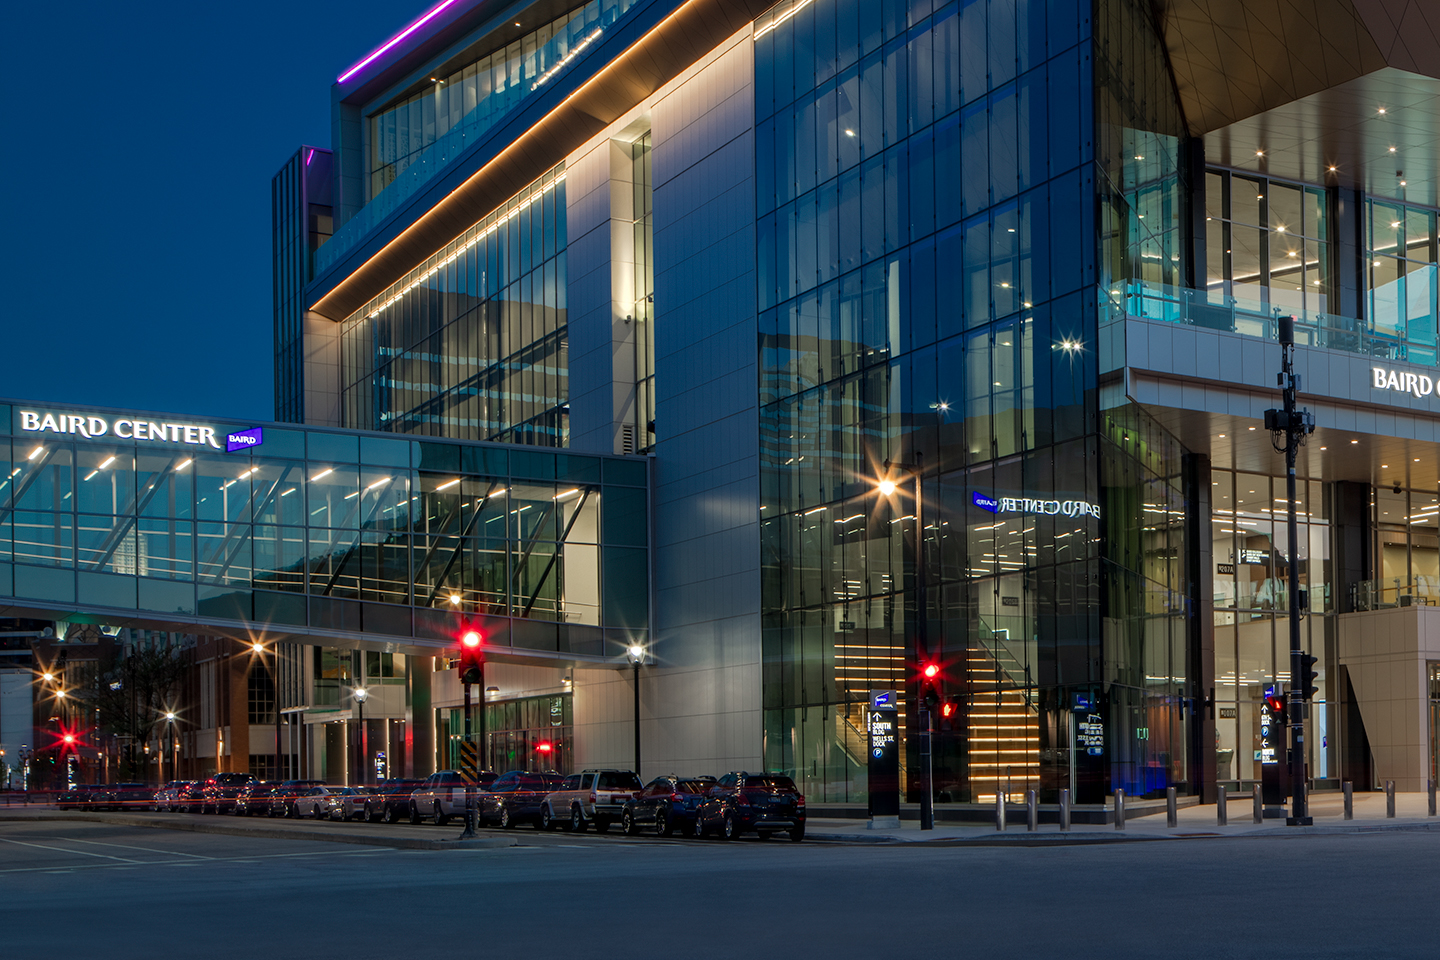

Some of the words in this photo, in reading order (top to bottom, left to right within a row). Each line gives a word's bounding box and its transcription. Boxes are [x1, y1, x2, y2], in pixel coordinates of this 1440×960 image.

[1373, 367, 1433, 399] BAIRD
[20, 411, 108, 439] BAIRD
[113, 419, 221, 450] CENTER
[228, 434, 257, 445] BAIRD
[872, 722, 892, 730] SOUTH
